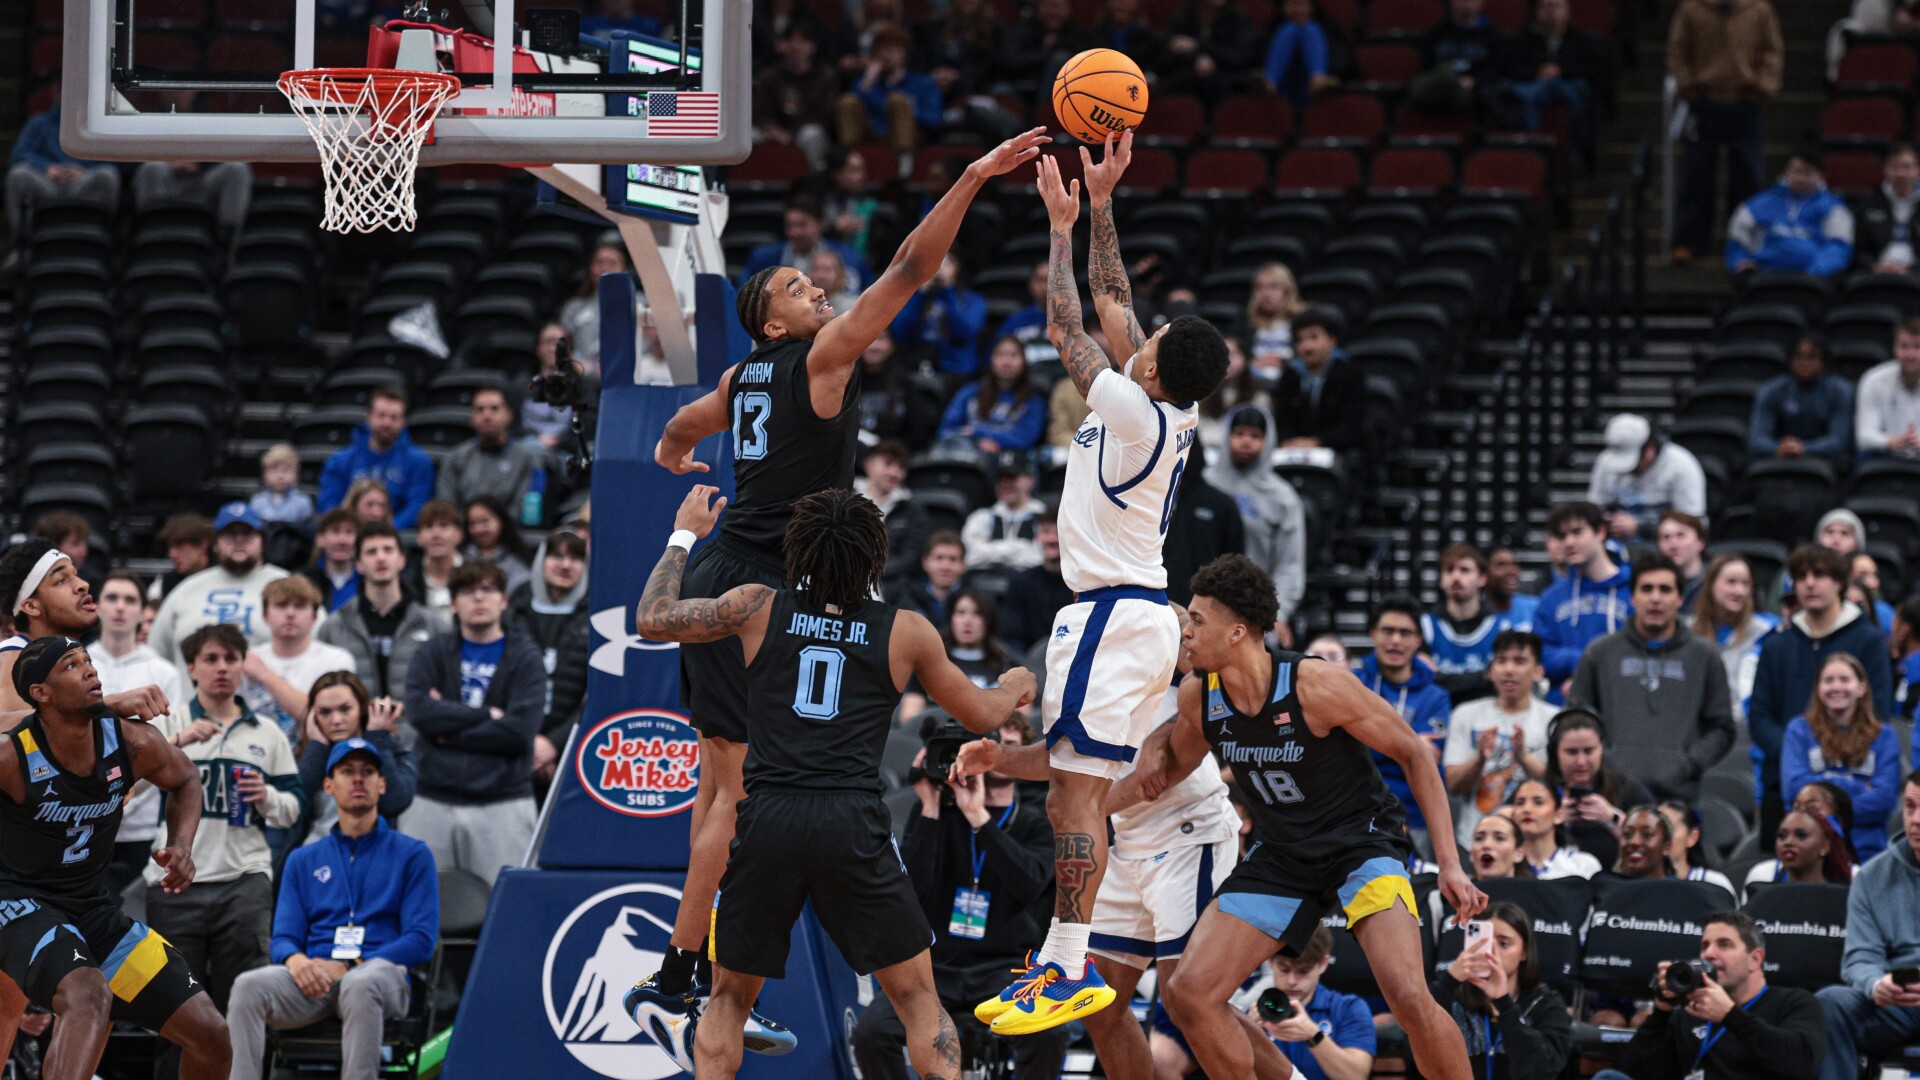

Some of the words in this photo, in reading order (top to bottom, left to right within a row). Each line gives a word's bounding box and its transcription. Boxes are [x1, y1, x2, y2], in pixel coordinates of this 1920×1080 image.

[733, 391, 772, 460] 13
[1160, 456, 1184, 536] 0
[786, 612, 843, 642] JAMES
[845, 621, 869, 645] JR.
[792, 645, 846, 720] 0
[627, 720, 652, 729] SINCE
[598, 730, 699, 769] Jersey
[1218, 741, 1304, 767] Marquette
[602, 760, 697, 792] Mike's
[1248, 770, 1305, 805] 18
[627, 793, 666, 807] SUBS
[61, 824, 94, 863] 2
[1534, 919, 1572, 936] Bank
[1608, 914, 1680, 934] Columbia
[1683, 921, 1702, 936] Ba
[1563, 963, 1571, 975] 2
[1608, 956, 1632, 968] Blue
[1763, 962, 1779, 971] lue
